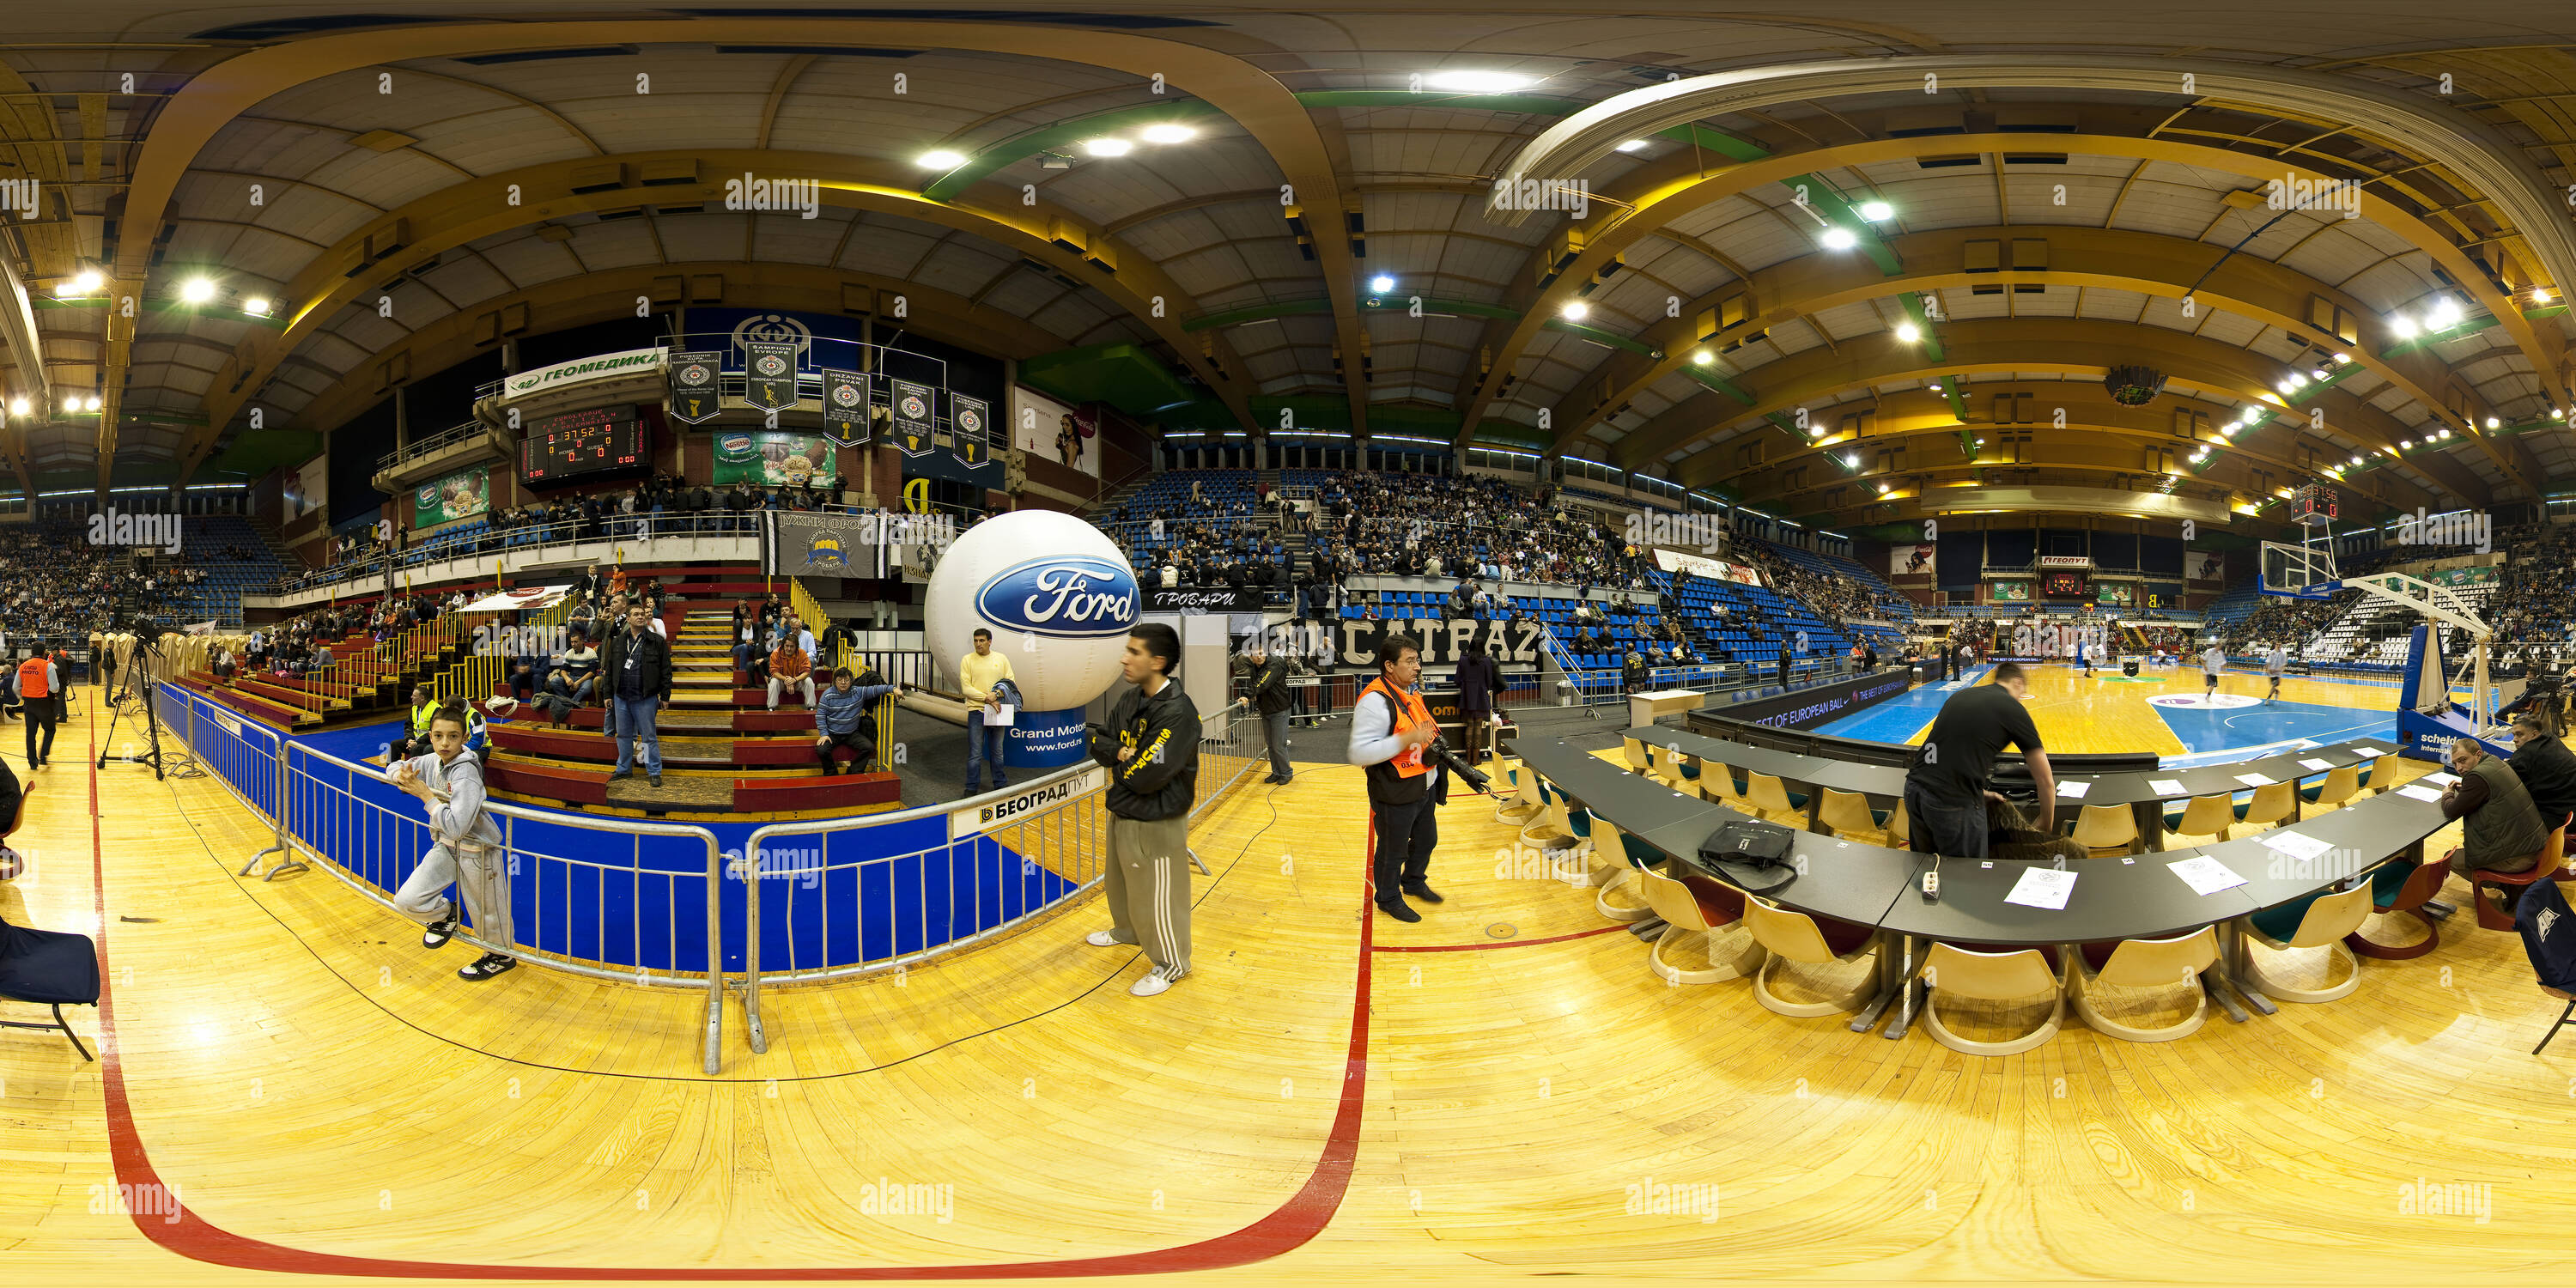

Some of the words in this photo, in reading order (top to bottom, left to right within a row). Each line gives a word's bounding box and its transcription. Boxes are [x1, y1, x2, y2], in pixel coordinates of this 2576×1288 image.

[544, 354, 659, 381] ГЕОМЕДИКА
[2306, 499, 2312, 513] 0
[1024, 566, 1135, 623] Ford
[1775, 712, 1788, 728] OF
[1790, 702, 1829, 724] EUROPEAN
[1829, 698, 1843, 711] BALL
[1010, 728, 1054, 738] Grand
[1058, 722, 1086, 736] Motors
[2421, 734, 2458, 745] scheld
[1026, 738, 1082, 752] www.ford.rs
[996, 774, 1089, 819] БЕОГРАДПУТ
